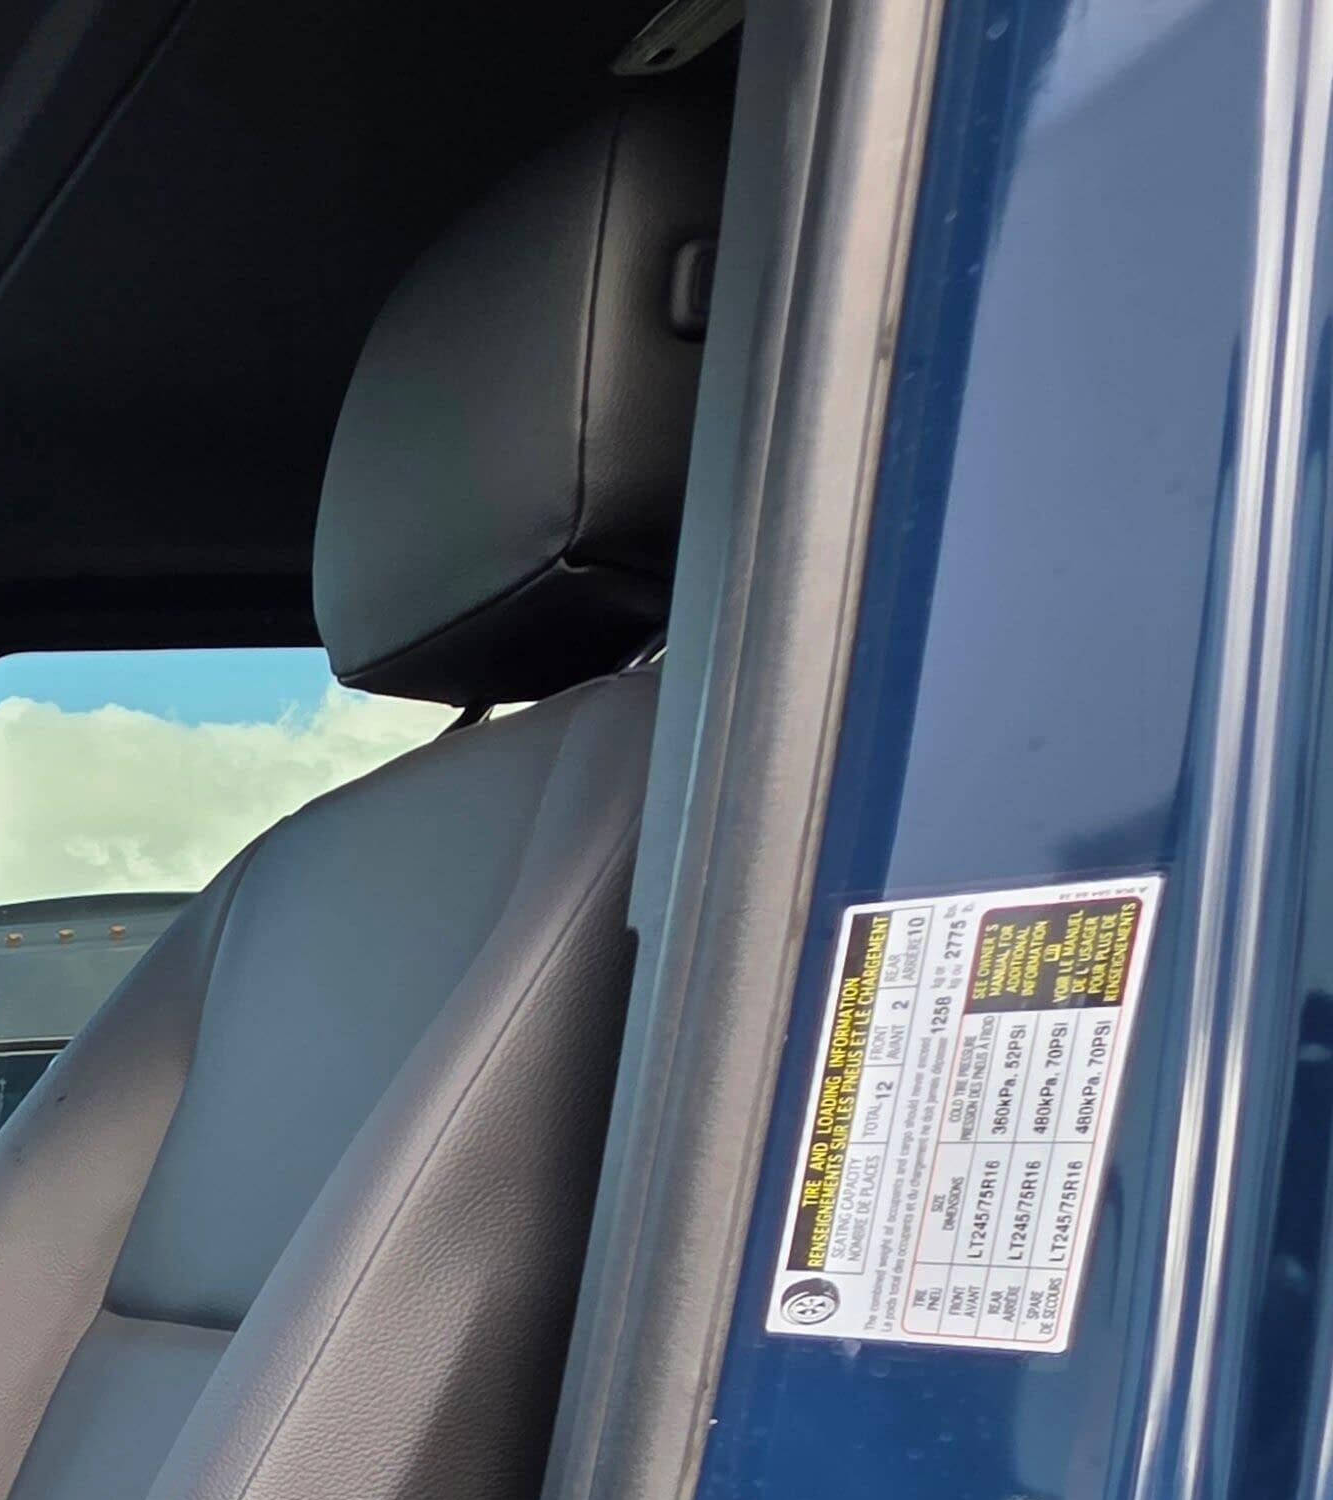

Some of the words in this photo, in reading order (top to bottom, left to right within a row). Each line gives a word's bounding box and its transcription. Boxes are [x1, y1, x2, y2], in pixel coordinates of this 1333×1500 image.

[906, 917, 925, 936] 10
[998, 924, 1015, 946] FOR
[1062, 909, 1084, 955] MANUEL
[1100, 914, 1117, 928] DE
[943, 920, 966, 959] 2775
[1093, 931, 1113, 960] PLUS
[1102, 902, 1137, 1001] RENSEIGNEMENTS
[857, 915, 890, 1004] CHARGEMENT
[884, 953, 902, 982] REAR
[988, 949, 1010, 995] MANUAL
[1005, 926, 1030, 992] ADDITIONAL
[1020, 920, 1048, 995] INFORMATION
[1058, 959, 1073, 972] LE
[971, 980, 988, 999] SEE
[1052, 975, 1070, 1002] VOIR
[1070, 978, 1086, 992] DE
[1087, 963, 1107, 993] POUR
[853, 1009, 871, 1023] LE
[891, 1000, 909, 1009] 2
[928, 996, 951, 1033] 1258
[827, 977, 860, 1067] INFORMATION
[849, 1030, 868, 1045] ET
[869, 1024, 888, 1059] FRONT
[886, 1023, 905, 1059] AVANT
[957, 1035, 976, 1076] PRESSURE
[1003, 1024, 1027, 1069] 52PSI
[1044, 1022, 1069, 1068] 70PSI
[1087, 1020, 1112, 1066] 70PSI
[840, 1050, 864, 1091] PNEUS
[953, 1079, 968, 1096] TIRE
[815, 1075, 841, 1133] LOADING
[835, 1096, 855, 1119] LES
[862, 1103, 882, 1136] TOTAL
[874, 1081, 893, 1098] 12
[948, 1098, 964, 1122] COLD
[829, 1125, 849, 1149] SUR
[808, 1142, 828, 1170] AND
[840, 1158, 863, 1210] CAPACITY
[860, 1155, 880, 1196] PLACES
[801, 1180, 821, 1206] TIRE
[807, 1154, 844, 1266] RENSEIGNEMENTS
[856, 1199, 871, 1213] DE
[931, 1194, 945, 1211] SIZE
[942, 1176, 964, 1230] DIMENSIONS
[966, 1160, 1001, 1258] LT245/75R16
[1006, 1160, 1042, 1260] LT245/75R16
[1048, 1160, 1085, 1261] LT245/75R16
[831, 1213, 852, 1258] SEATING
[848, 1216, 868, 1259] NOMBRE
[912, 1289, 926, 1307] TIRE
[927, 1287, 942, 1310] PNEU
[948, 1286, 966, 1315] FRONT
[963, 1284, 981, 1317] AVANT
[987, 1290, 1003, 1314] REAR
[1026, 1290, 1044, 1319] SPARE
[1042, 1277, 1062, 1318] SECOURS
[1040, 1320, 1054, 1333] DE
